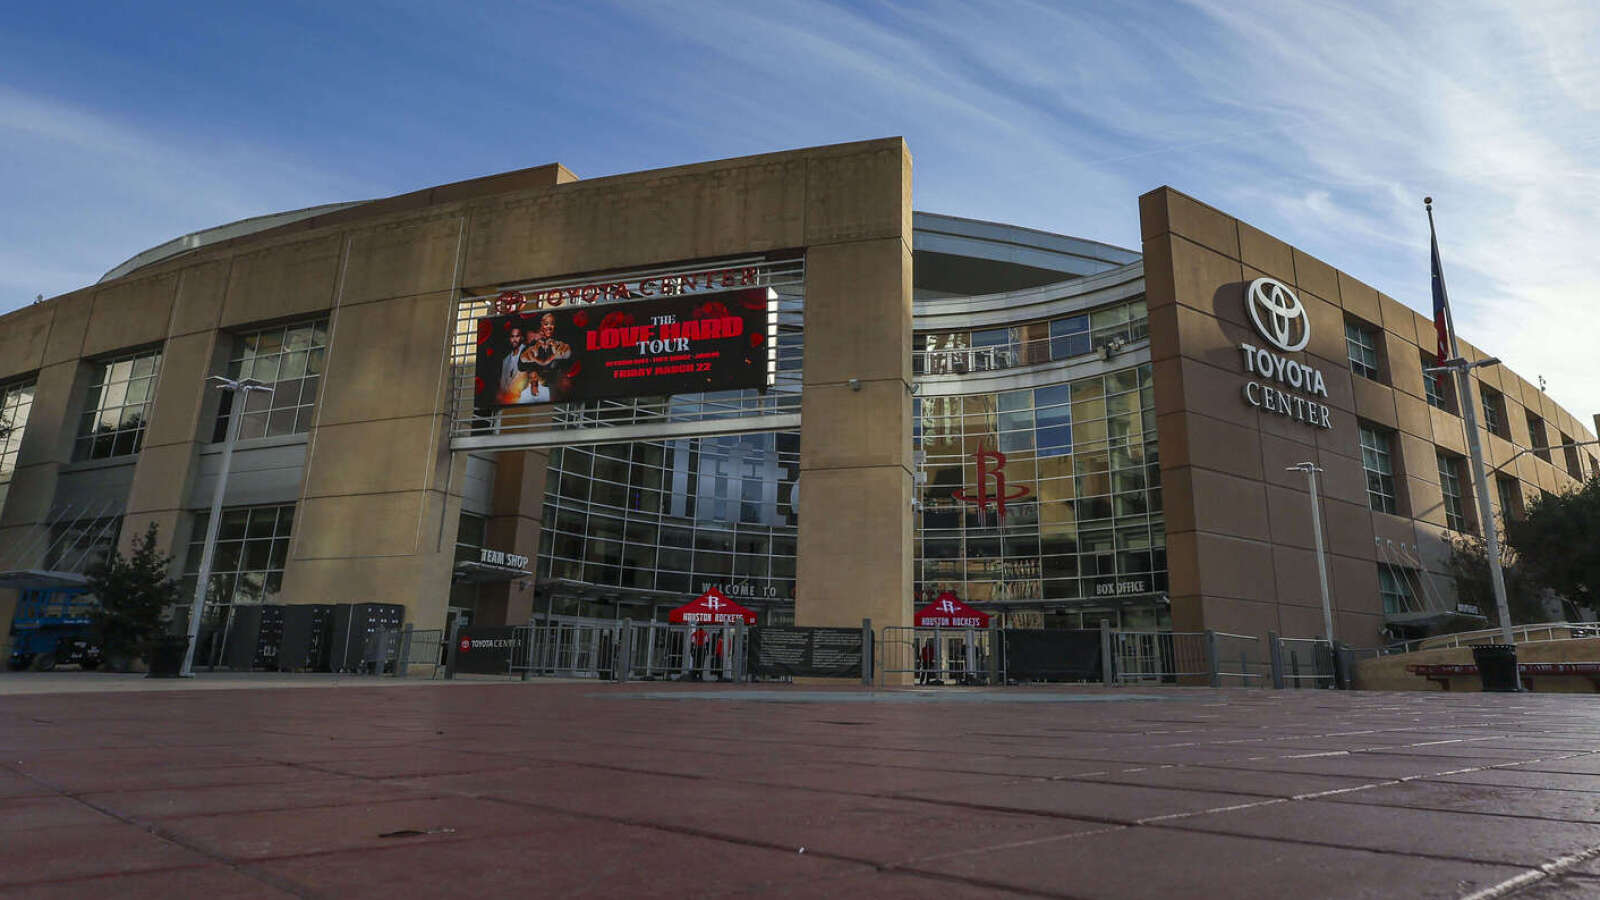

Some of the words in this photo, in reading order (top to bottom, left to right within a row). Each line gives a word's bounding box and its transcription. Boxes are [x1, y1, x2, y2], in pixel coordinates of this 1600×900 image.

[536, 282, 631, 308] TOYOTA
[640, 267, 757, 296] CENTER
[651, 314, 676, 326] THE
[586, 324, 655, 351] LOVE
[660, 316, 743, 340] HARD
[636, 337, 690, 355] TOUR
[613, 367, 653, 379] FRIDAY
[655, 363, 694, 376] MARCH
[696, 362, 712, 372] 22
[1241, 343, 1328, 397] TOYOTA
[1245, 381, 1332, 428] CENTER
[480, 548, 504, 565] TEAM
[506, 553, 528, 569] SHOP
[763, 586, 776, 597] TO
[1096, 583, 1115, 595] BOX
[1117, 581, 1145, 593] OFFICE
[683, 613, 712, 622] HOUSTON
[921, 616, 950, 626] HOUSTON
[952, 616, 980, 626] ROCKETS
[471, 640, 493, 648] TOYOTA
